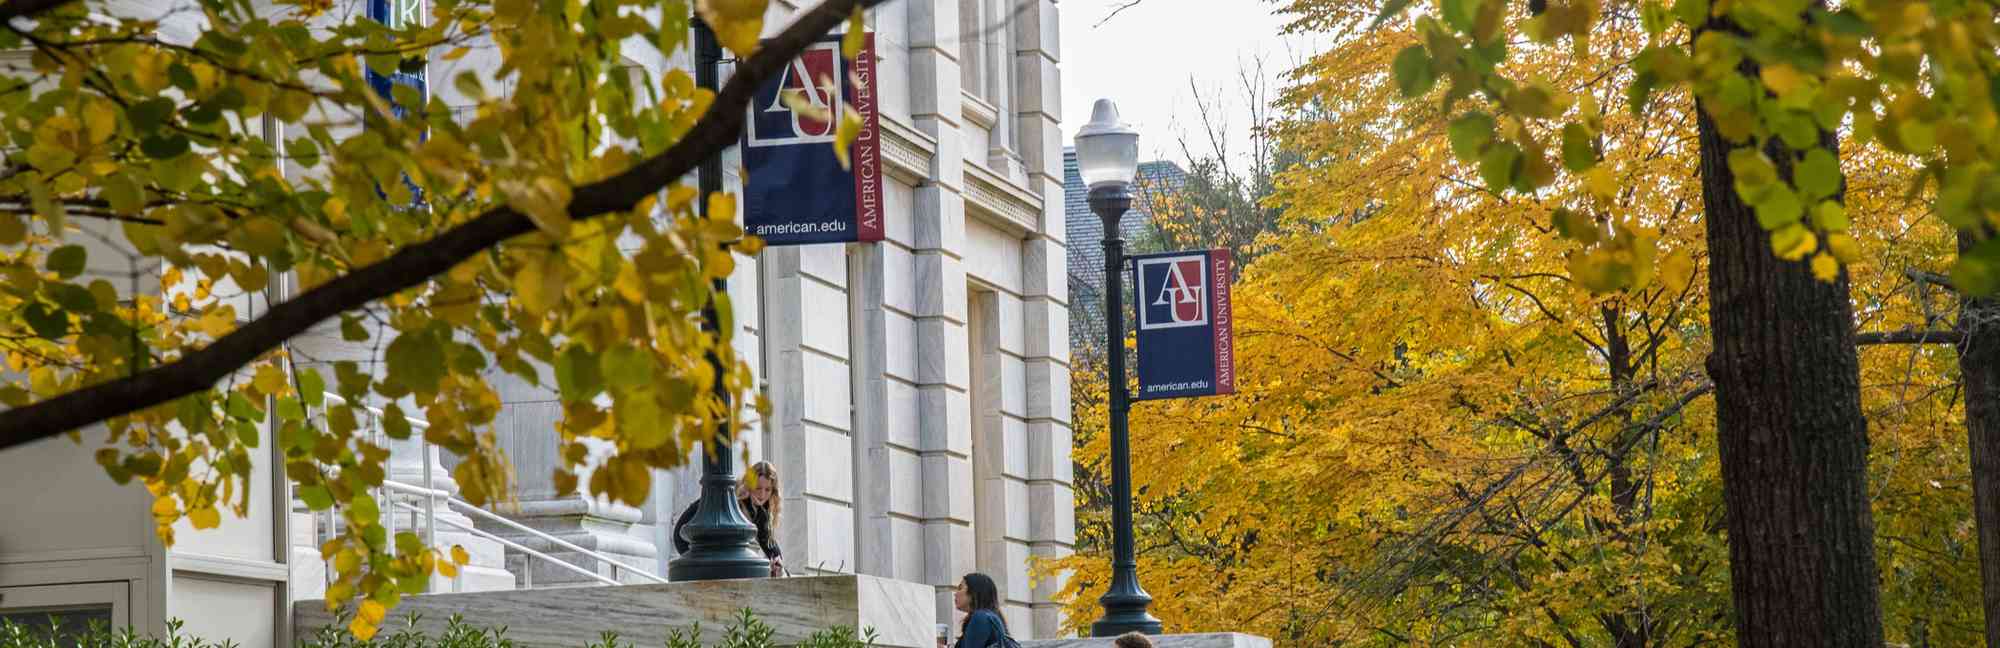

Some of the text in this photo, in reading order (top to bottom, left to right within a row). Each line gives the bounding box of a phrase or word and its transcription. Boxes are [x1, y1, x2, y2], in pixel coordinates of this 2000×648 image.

[764, 57, 833, 138] AU
[856, 49, 877, 230] AMERICAN UNIVERSITY
[756, 219, 846, 235] american.edu
[1152, 259, 1201, 323] AU
[1216, 258, 1230, 386] AMERICAN UNIVERSITY
[1147, 378, 1208, 393] american.edu
